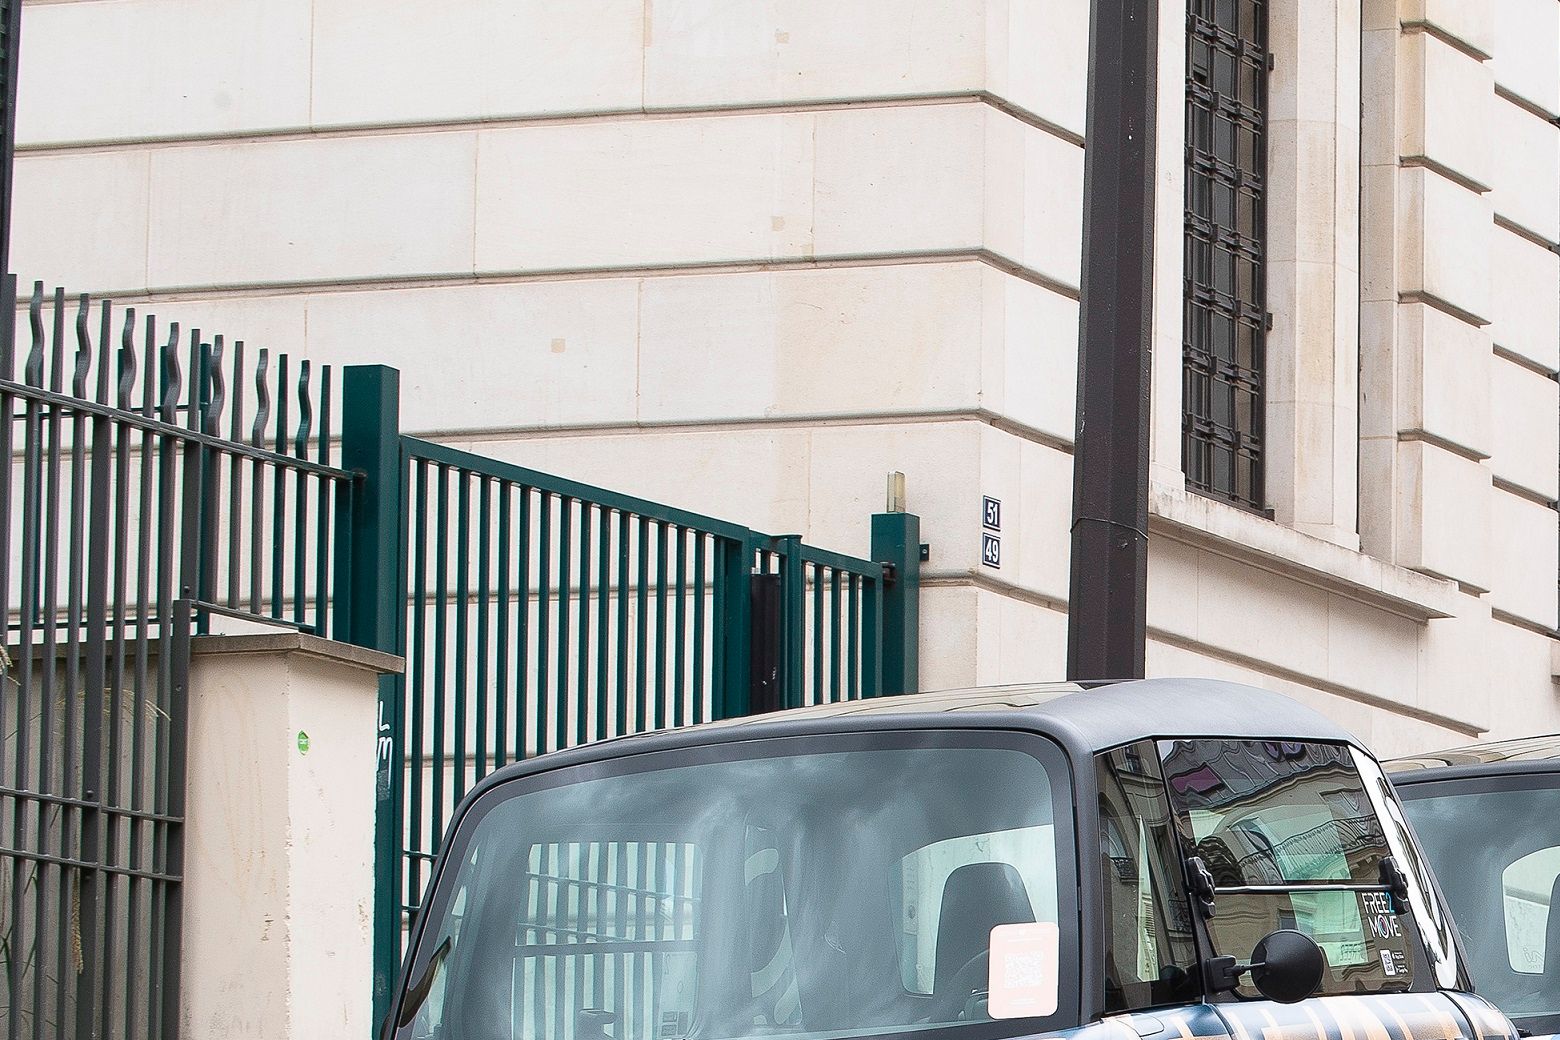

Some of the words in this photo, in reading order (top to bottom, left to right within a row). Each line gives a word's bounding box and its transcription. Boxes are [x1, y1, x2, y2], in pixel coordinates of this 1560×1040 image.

[987, 501, 998, 525] 51
[986, 538, 999, 562] 49
[1361, 891, 1395, 914] FREE2
[1367, 914, 1402, 939] MOVE
